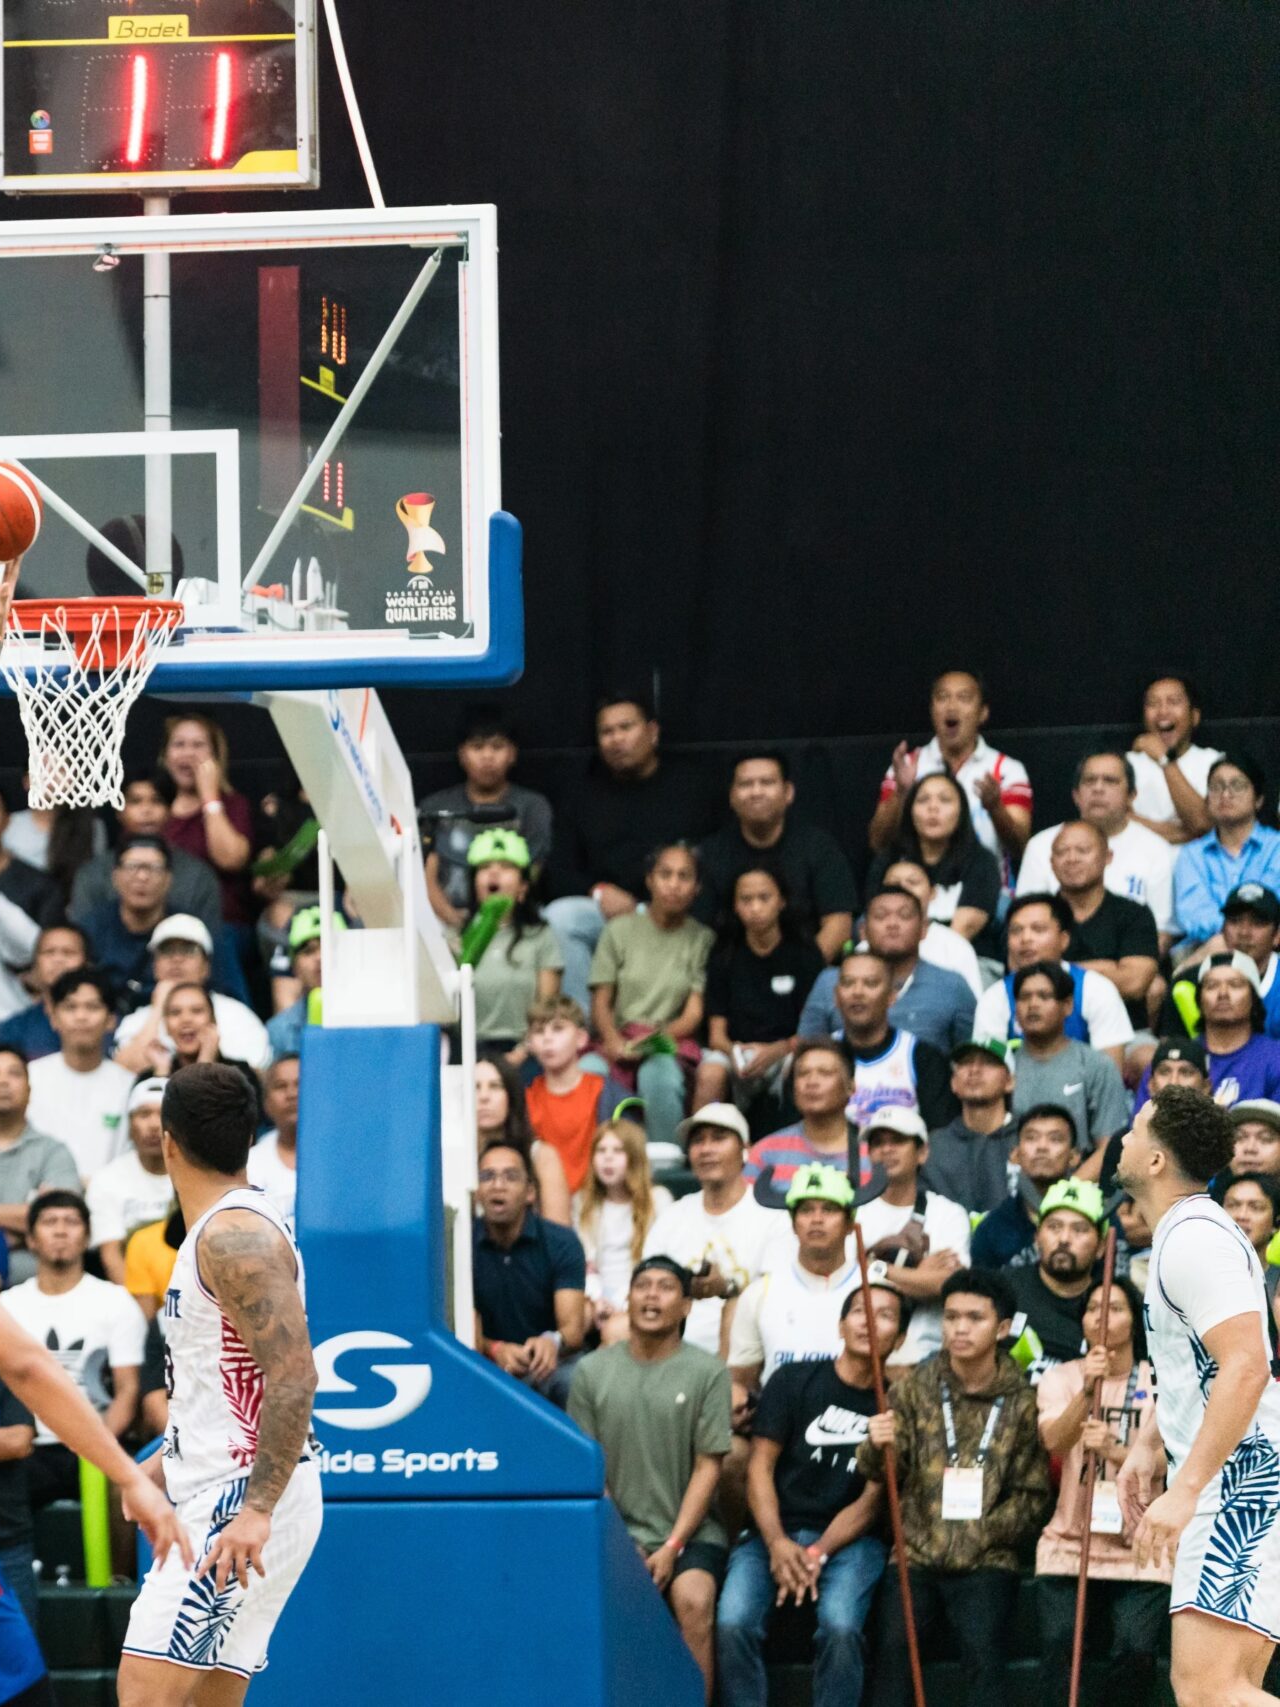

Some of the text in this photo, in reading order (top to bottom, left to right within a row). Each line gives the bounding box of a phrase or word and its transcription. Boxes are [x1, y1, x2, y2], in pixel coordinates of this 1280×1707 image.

[114, 19, 184, 39] Bodet
[125, 52, 231, 163] 11
[385, 595, 456, 607] WORLD CUP
[385, 606, 457, 624] QUALIFIERS
[818, 1404, 869, 1434] NIKE
[316, 1447, 499, 1479] lde Sports
[809, 1446, 858, 1474] AIR
